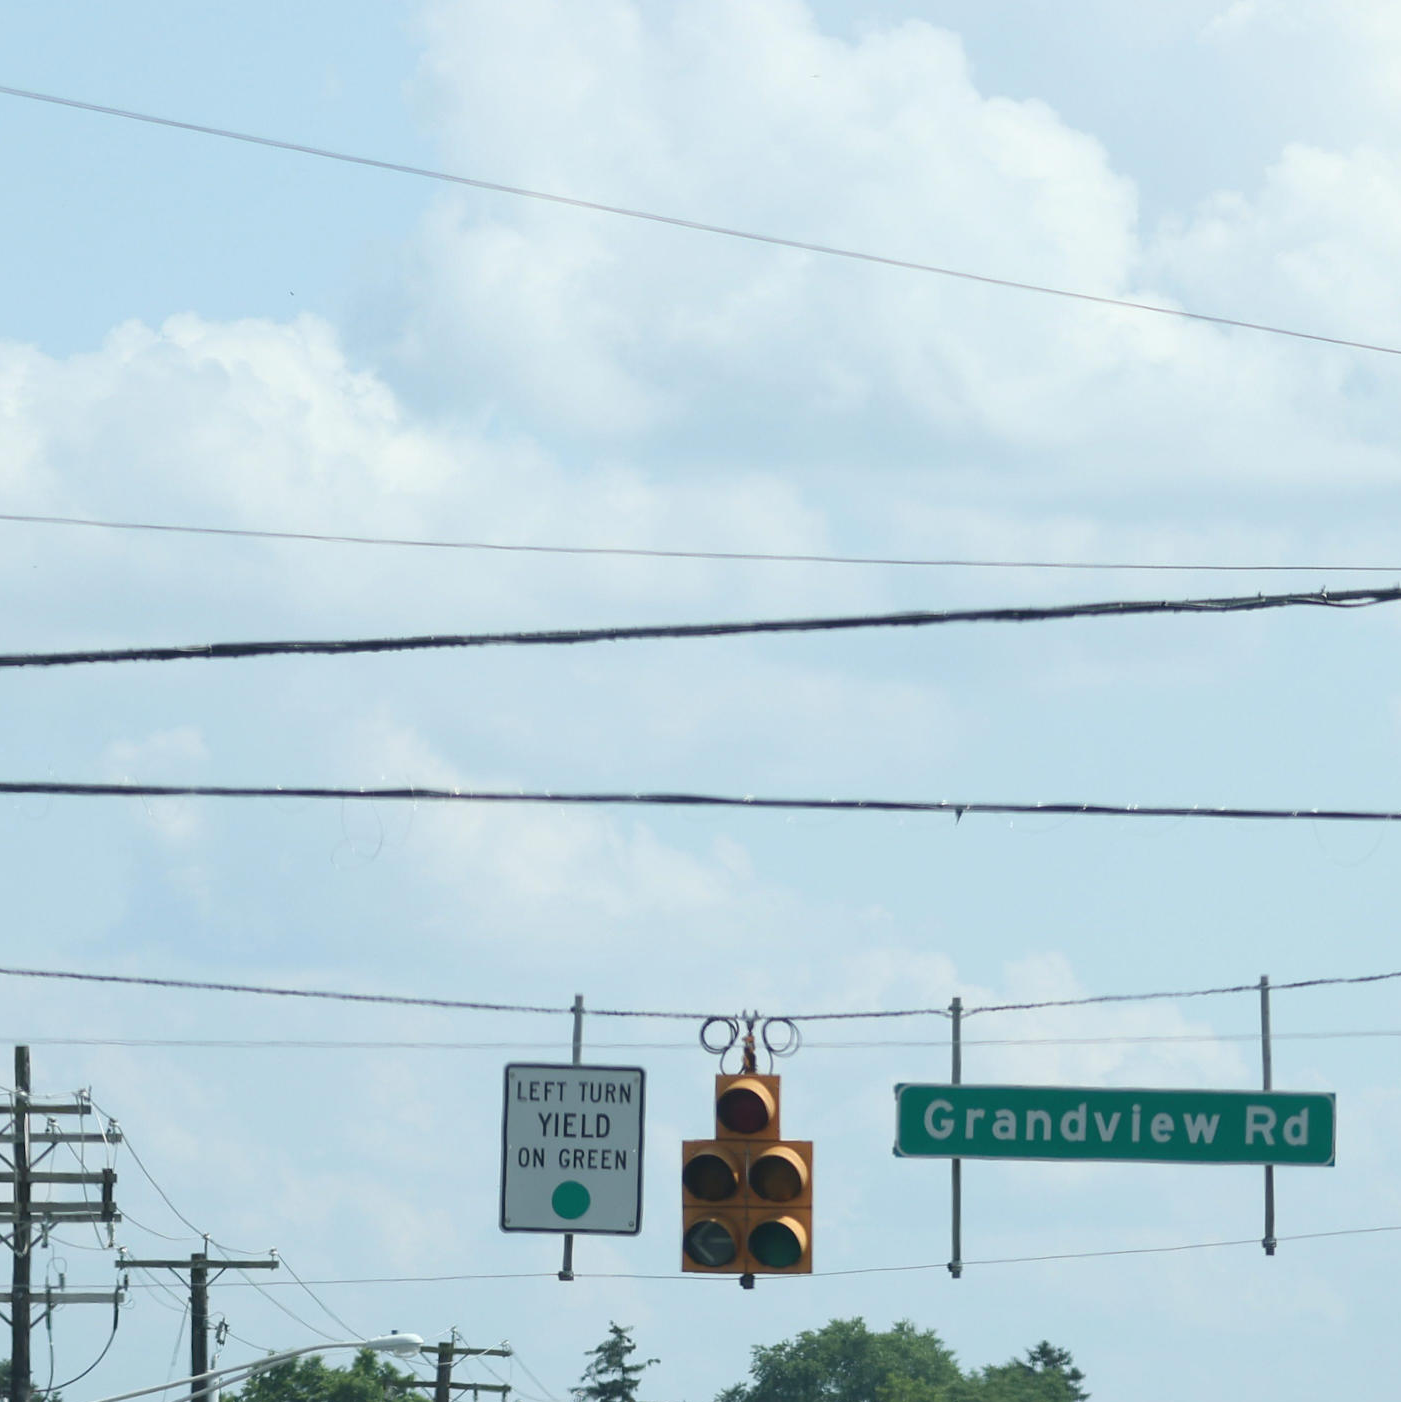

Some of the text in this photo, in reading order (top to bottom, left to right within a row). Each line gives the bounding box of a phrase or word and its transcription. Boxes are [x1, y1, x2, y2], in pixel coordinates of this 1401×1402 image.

[517, 1081, 632, 1104] LEFT TURN
[538, 1112, 611, 1138] YIELD
[924, 1099, 1310, 1147] Grandview Rd
[518, 1147, 627, 1171] ON GREEN
